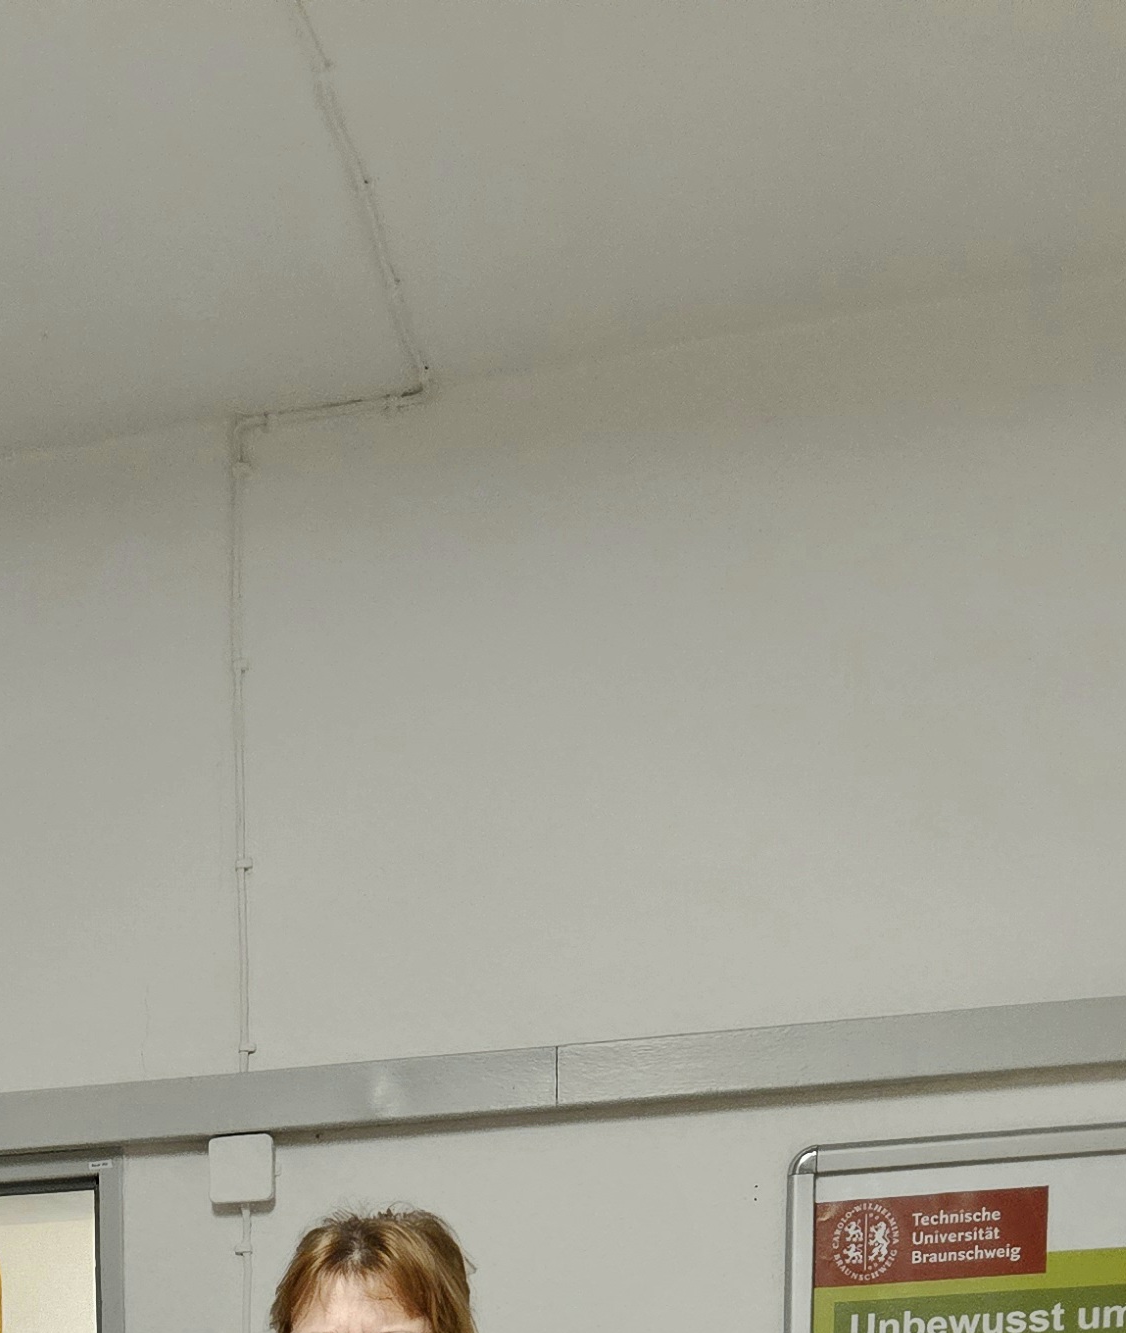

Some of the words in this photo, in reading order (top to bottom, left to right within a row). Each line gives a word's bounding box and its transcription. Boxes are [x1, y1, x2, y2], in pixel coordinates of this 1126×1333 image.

[912, 1207, 1001, 1226] Technische
[912, 1226, 1000, 1246] Universität
[911, 1244, 1021, 1264] Braunschweig
